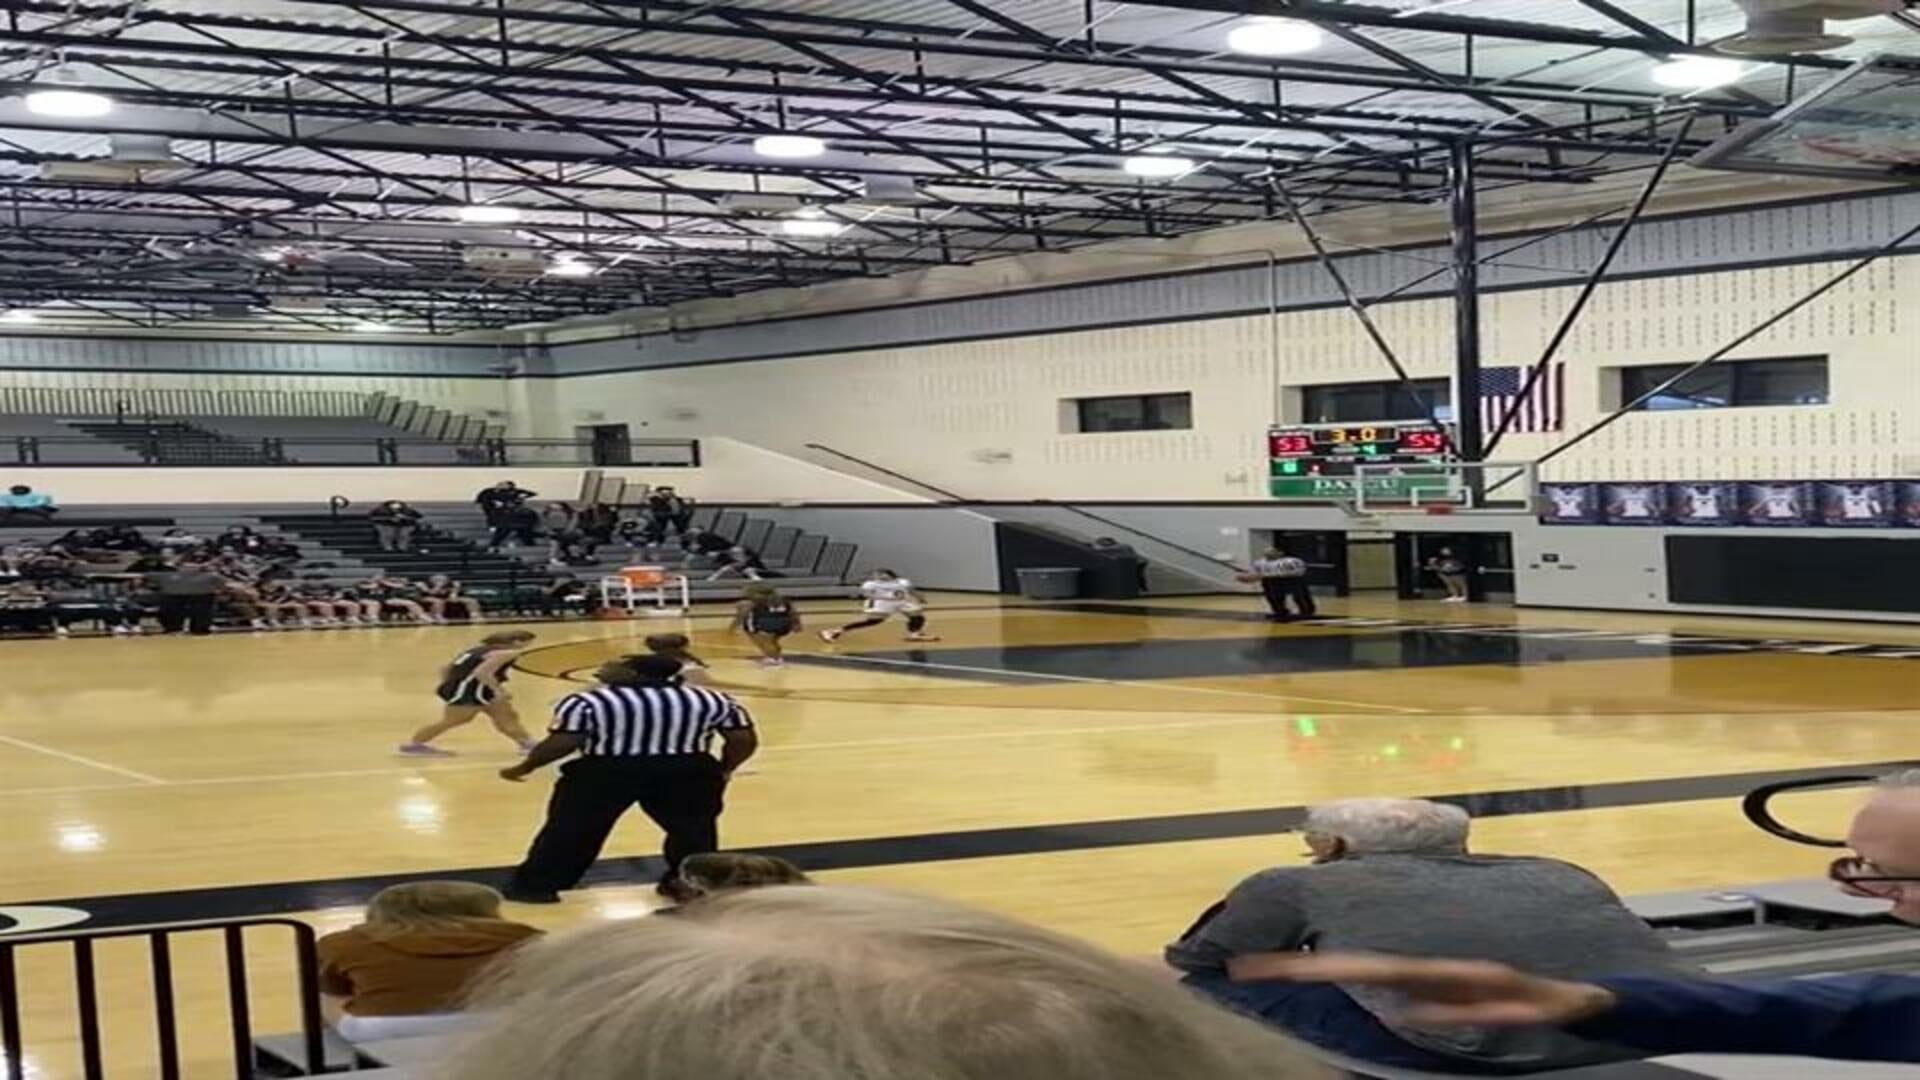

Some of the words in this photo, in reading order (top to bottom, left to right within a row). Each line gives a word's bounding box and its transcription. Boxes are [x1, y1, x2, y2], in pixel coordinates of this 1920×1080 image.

[1331, 427, 1377, 442] 3.0
[1408, 433, 1441, 447] 54
[1278, 437, 1307, 450] 53
